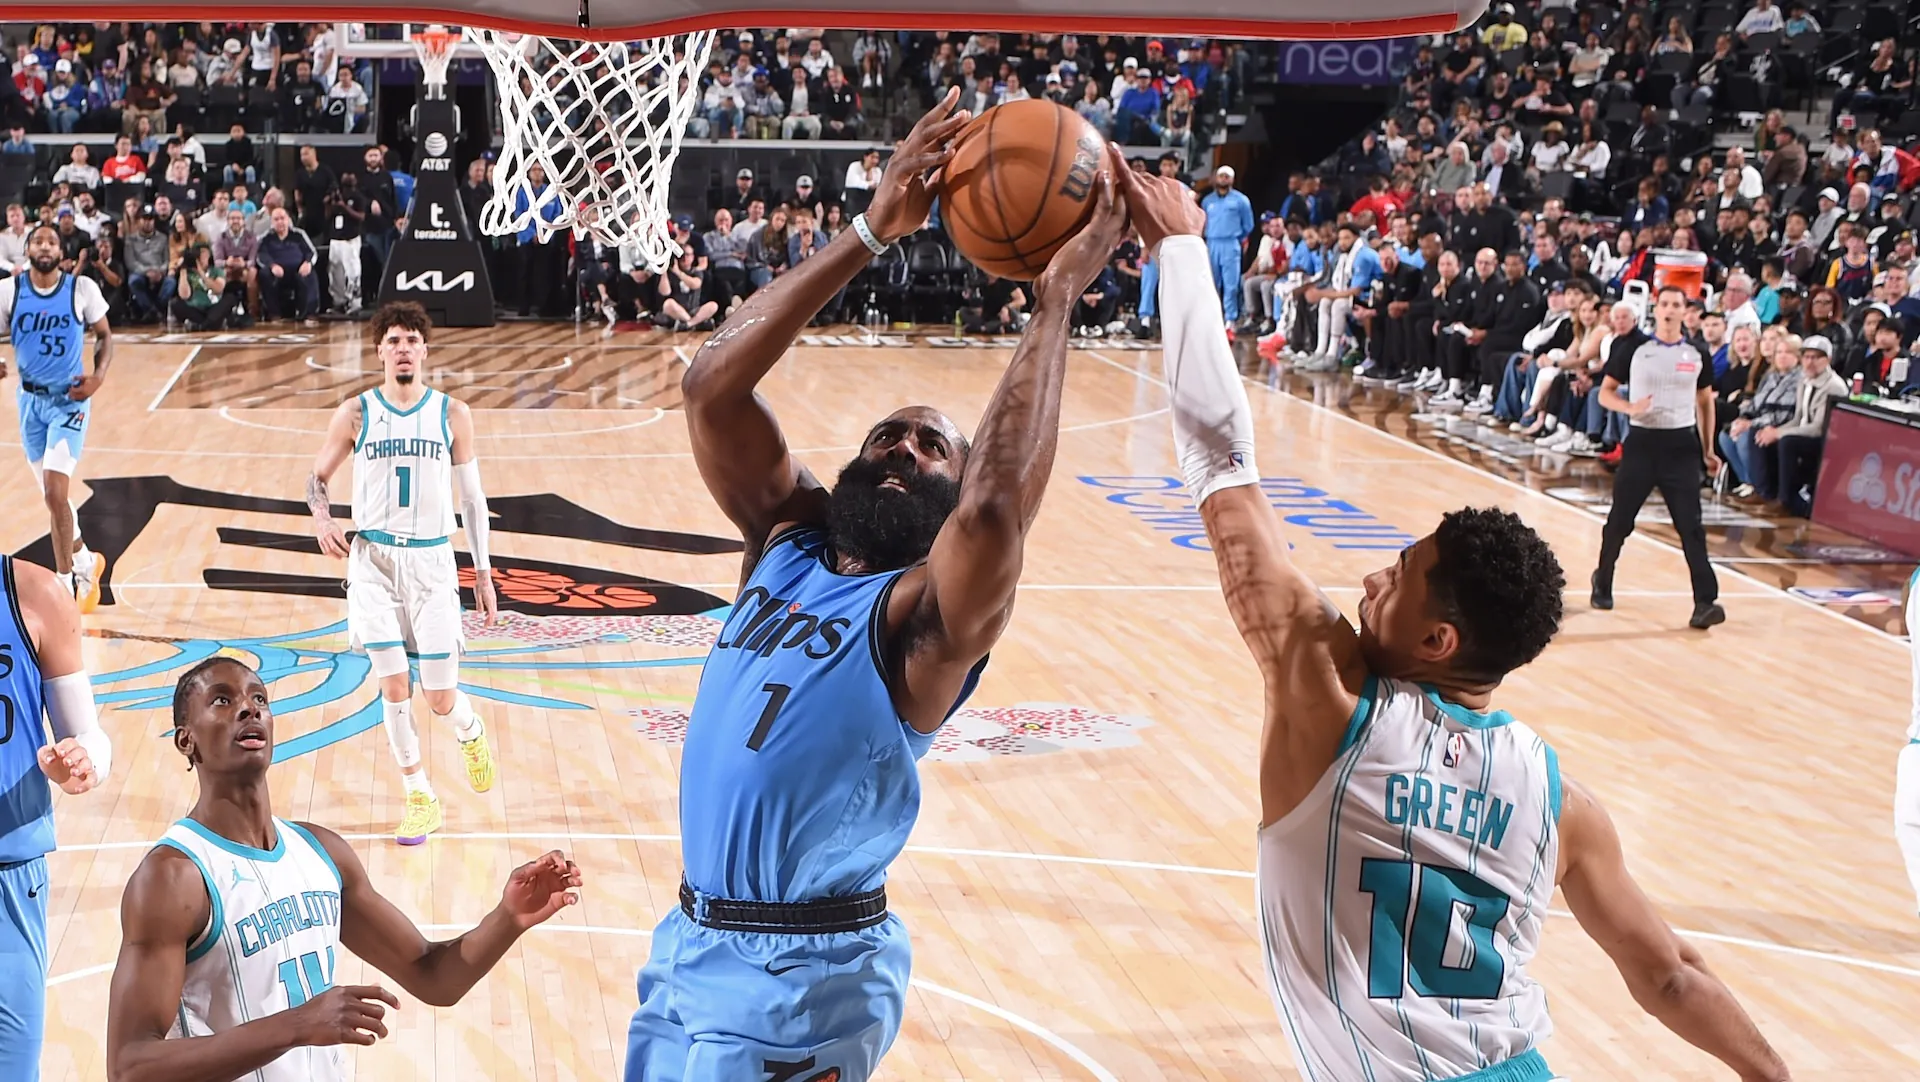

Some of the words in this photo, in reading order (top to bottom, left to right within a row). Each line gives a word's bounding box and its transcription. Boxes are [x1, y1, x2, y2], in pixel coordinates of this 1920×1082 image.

[420, 158, 451, 171] AT&T
[414, 228, 457, 240] teradata
[17, 310, 70, 334] Clips
[38, 333, 66, 357] 55
[364, 438, 443, 461] CHARLOTTE
[395, 466, 411, 508] 1
[717, 586, 851, 660] Clips
[745, 682, 793, 753] 1
[1384, 773, 1514, 851] GREEN
[234, 890, 339, 958] CHARLOTT
[1359, 857, 1511, 1000] 10
